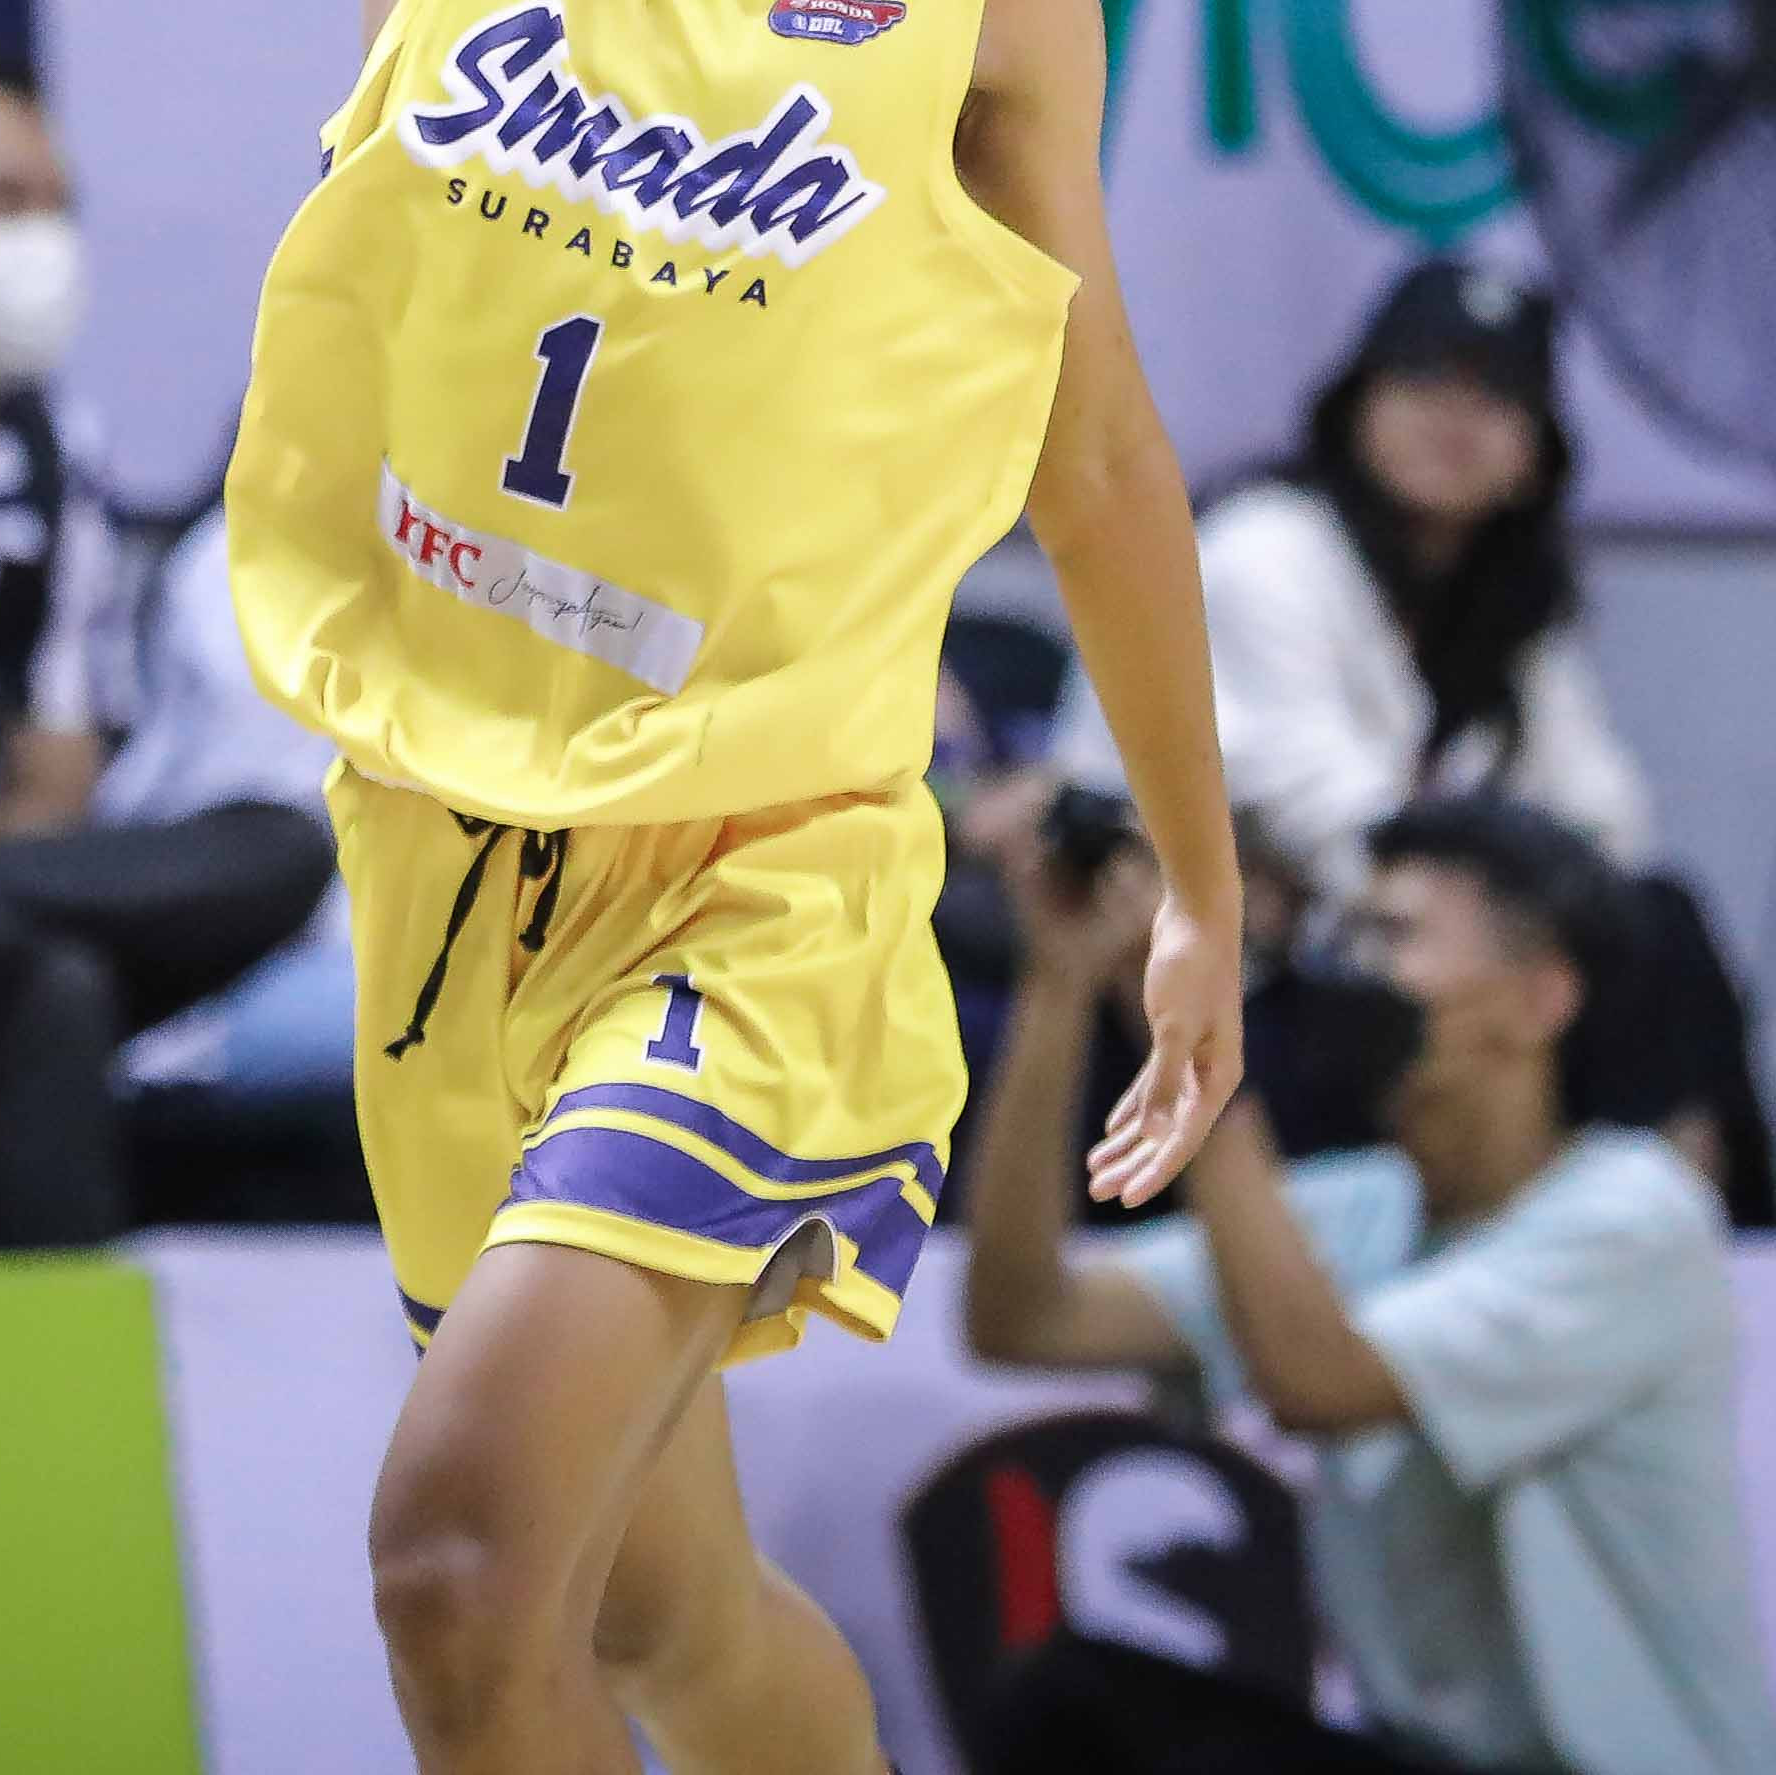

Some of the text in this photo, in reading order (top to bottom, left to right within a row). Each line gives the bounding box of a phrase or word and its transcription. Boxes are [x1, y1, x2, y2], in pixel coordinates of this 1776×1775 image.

[407, 2, 875, 248] Smada
[444, 176, 770, 309] SURABAYA
[497, 312, 605, 510] 1
[645, 972, 705, 1073] 1
